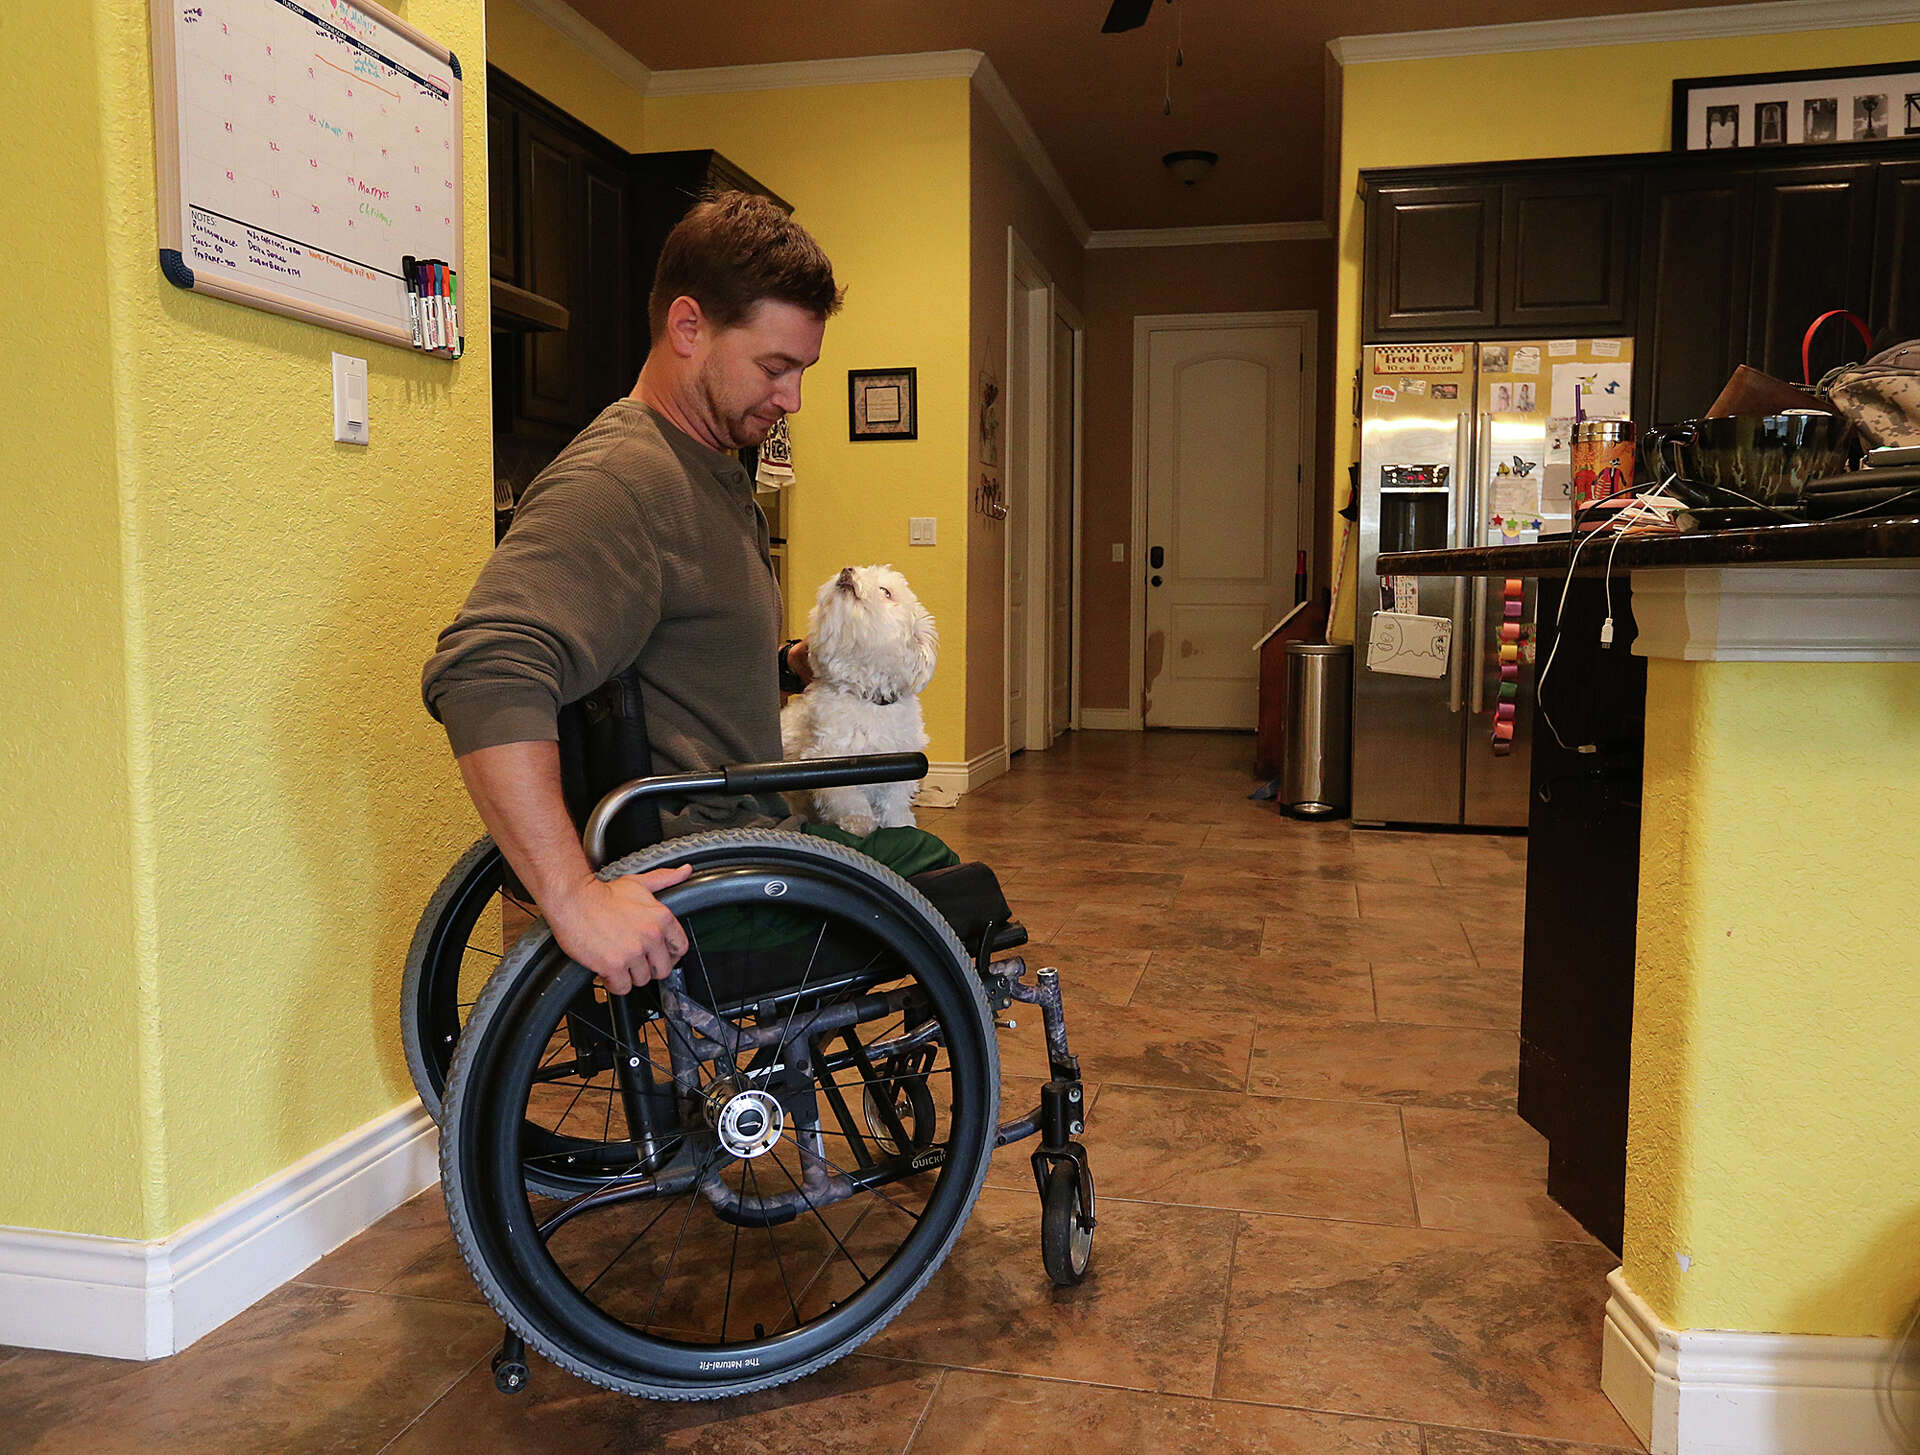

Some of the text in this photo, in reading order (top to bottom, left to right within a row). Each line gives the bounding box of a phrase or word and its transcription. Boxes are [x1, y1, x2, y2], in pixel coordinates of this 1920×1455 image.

[318, 18, 346, 40] WEDNESDAY
[357, 41, 380, 59] THURSDAY
[423, 80, 443, 96] SATURDAY
[191, 210, 217, 226] NOTES:
[1385, 353, 1455, 365] Fresh Eggs
[699, 1357, 760, 1371] The Natural-Fit
